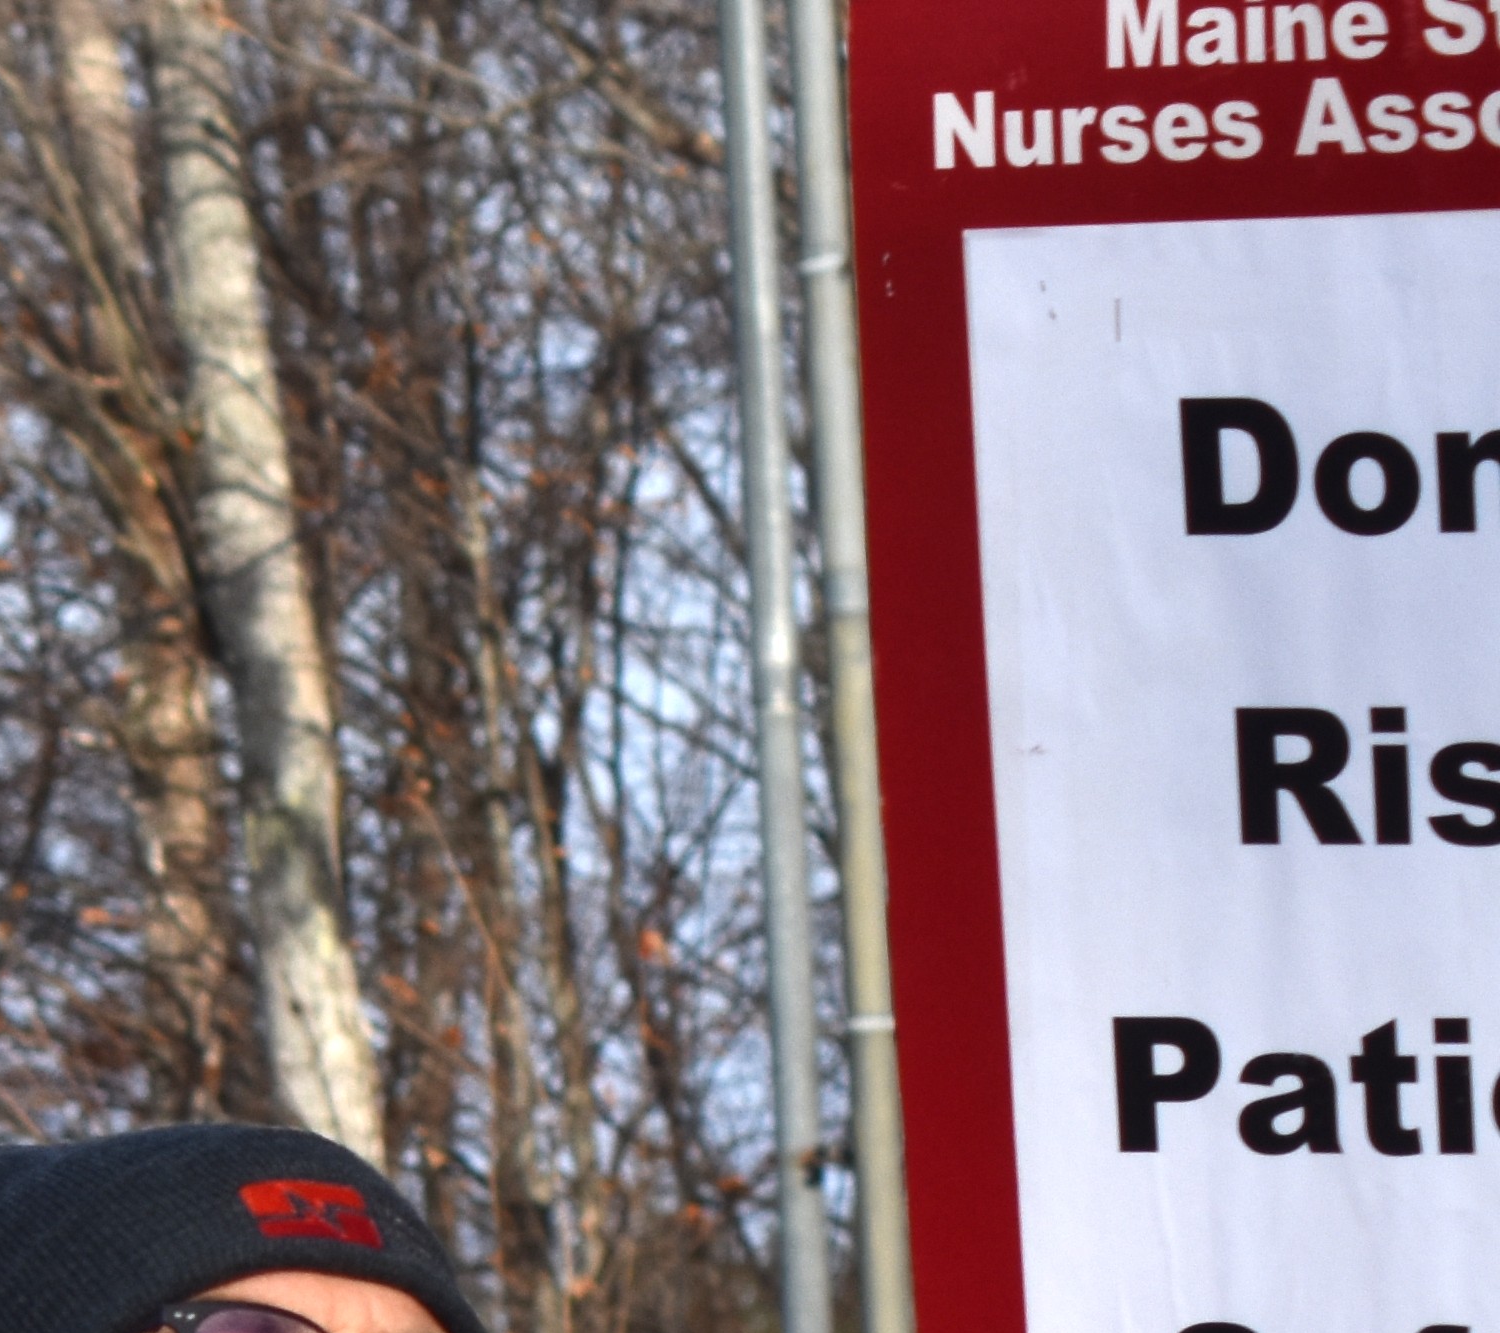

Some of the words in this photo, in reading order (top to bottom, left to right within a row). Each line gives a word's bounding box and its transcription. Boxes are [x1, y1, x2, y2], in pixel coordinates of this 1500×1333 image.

[1105, 0, 1388, 70] Maine
[933, 89, 1263, 170] Nurses
[1111, 1015, 1500, 1157] Pati
